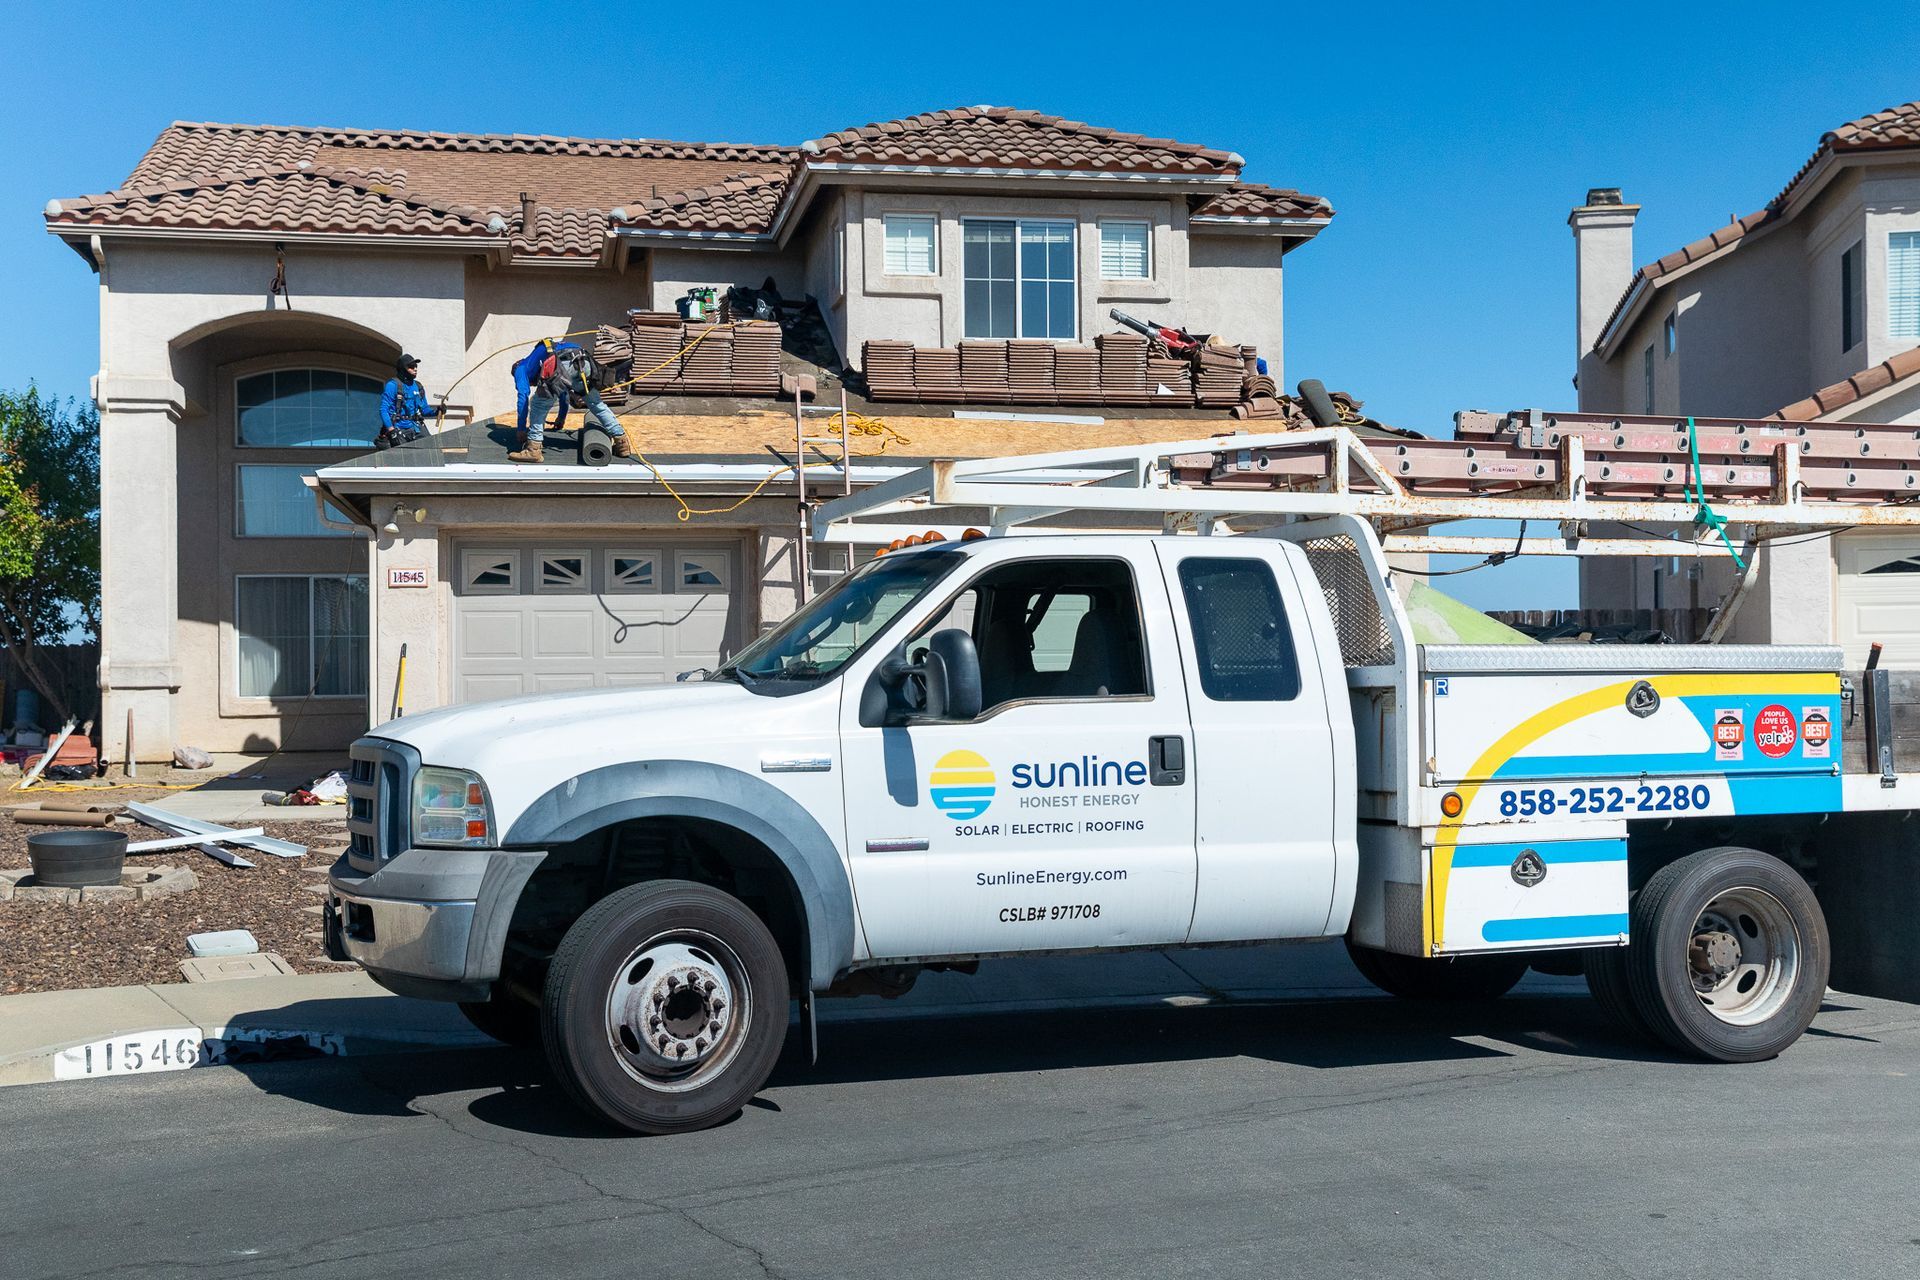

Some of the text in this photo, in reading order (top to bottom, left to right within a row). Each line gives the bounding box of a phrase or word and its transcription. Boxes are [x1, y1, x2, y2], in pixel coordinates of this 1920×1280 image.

[393, 572, 424, 583] 11545
[1436, 680, 1448, 694] R
[1718, 726, 1740, 739] BEST
[1805, 724, 1828, 737] BEST
[1759, 732, 1783, 746] yelp
[1012, 755, 1147, 788] sunline
[1020, 794, 1140, 808] HONEST ENERGY
[1500, 785, 1710, 816] 858-252-2280
[955, 820, 1144, 836] SOLAR ELECTRIC ROOFING
[976, 869, 1127, 886] SunlineEnergy.com
[999, 904, 1101, 923] CSLB# 971708
[85, 1039, 196, 1073] 11546
